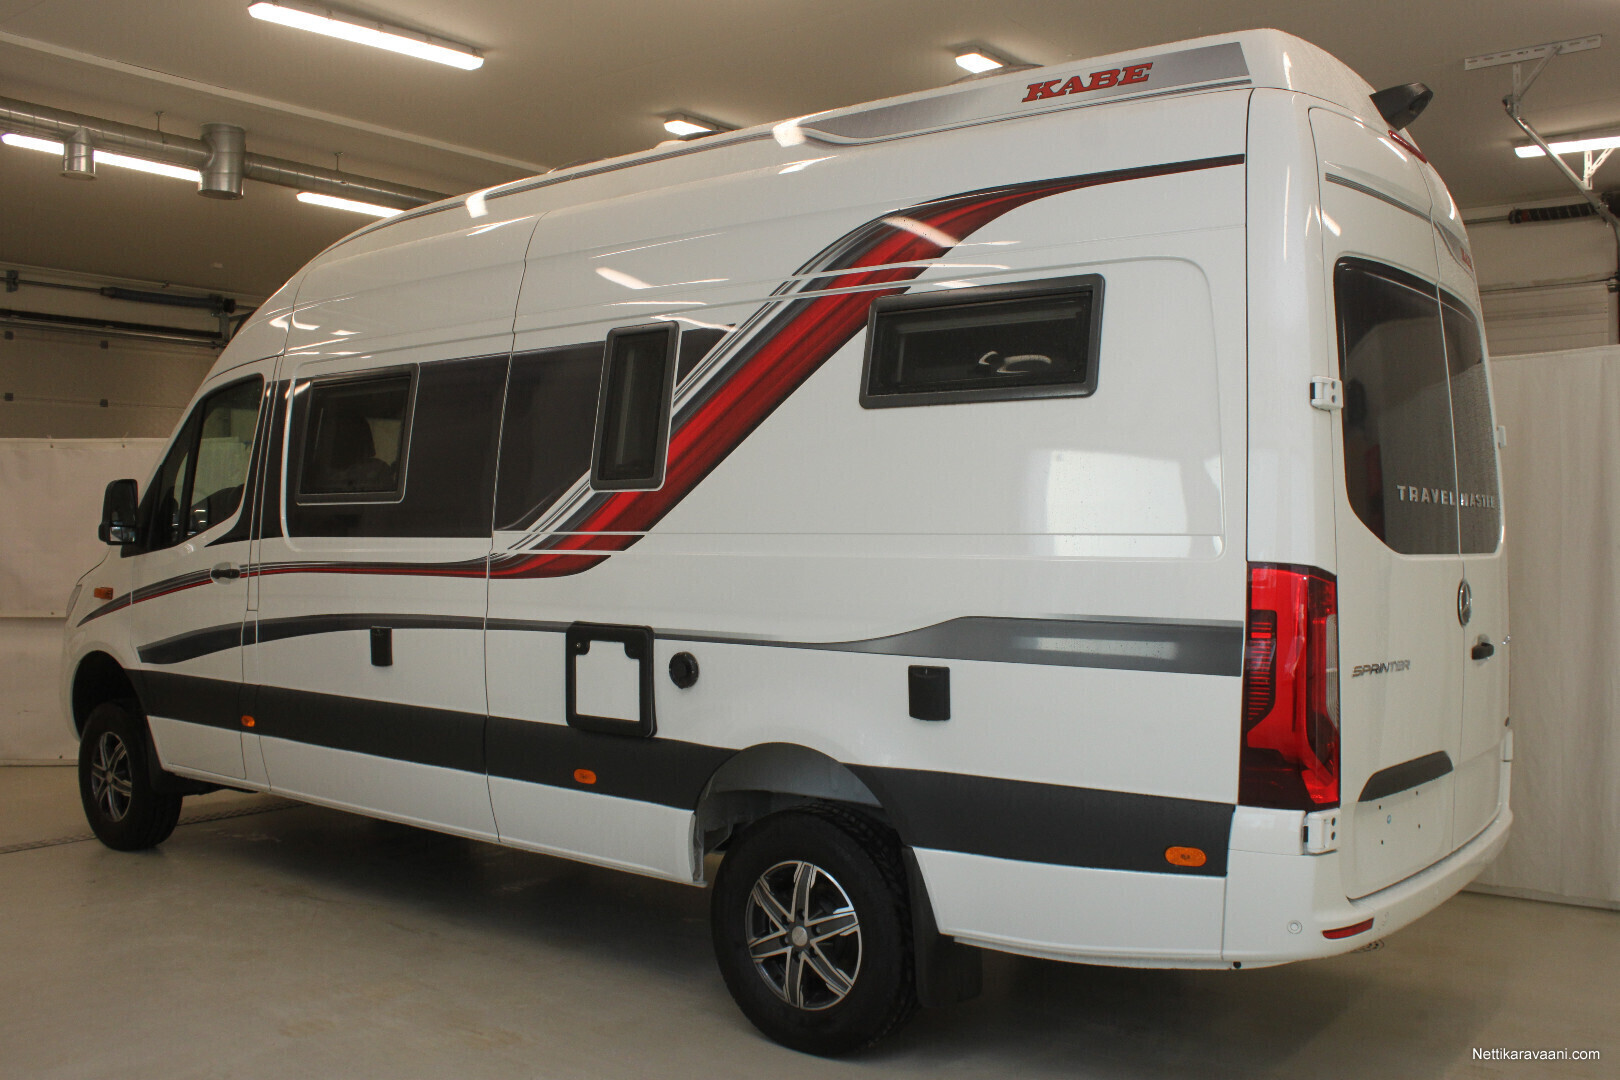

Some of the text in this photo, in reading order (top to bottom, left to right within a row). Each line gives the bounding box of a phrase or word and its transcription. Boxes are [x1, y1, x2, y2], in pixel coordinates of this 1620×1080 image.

[1022, 62, 1153, 102] KABE
[1397, 485, 1456, 506] TRAVEL
[1352, 659, 1411, 678] SPRINTER
